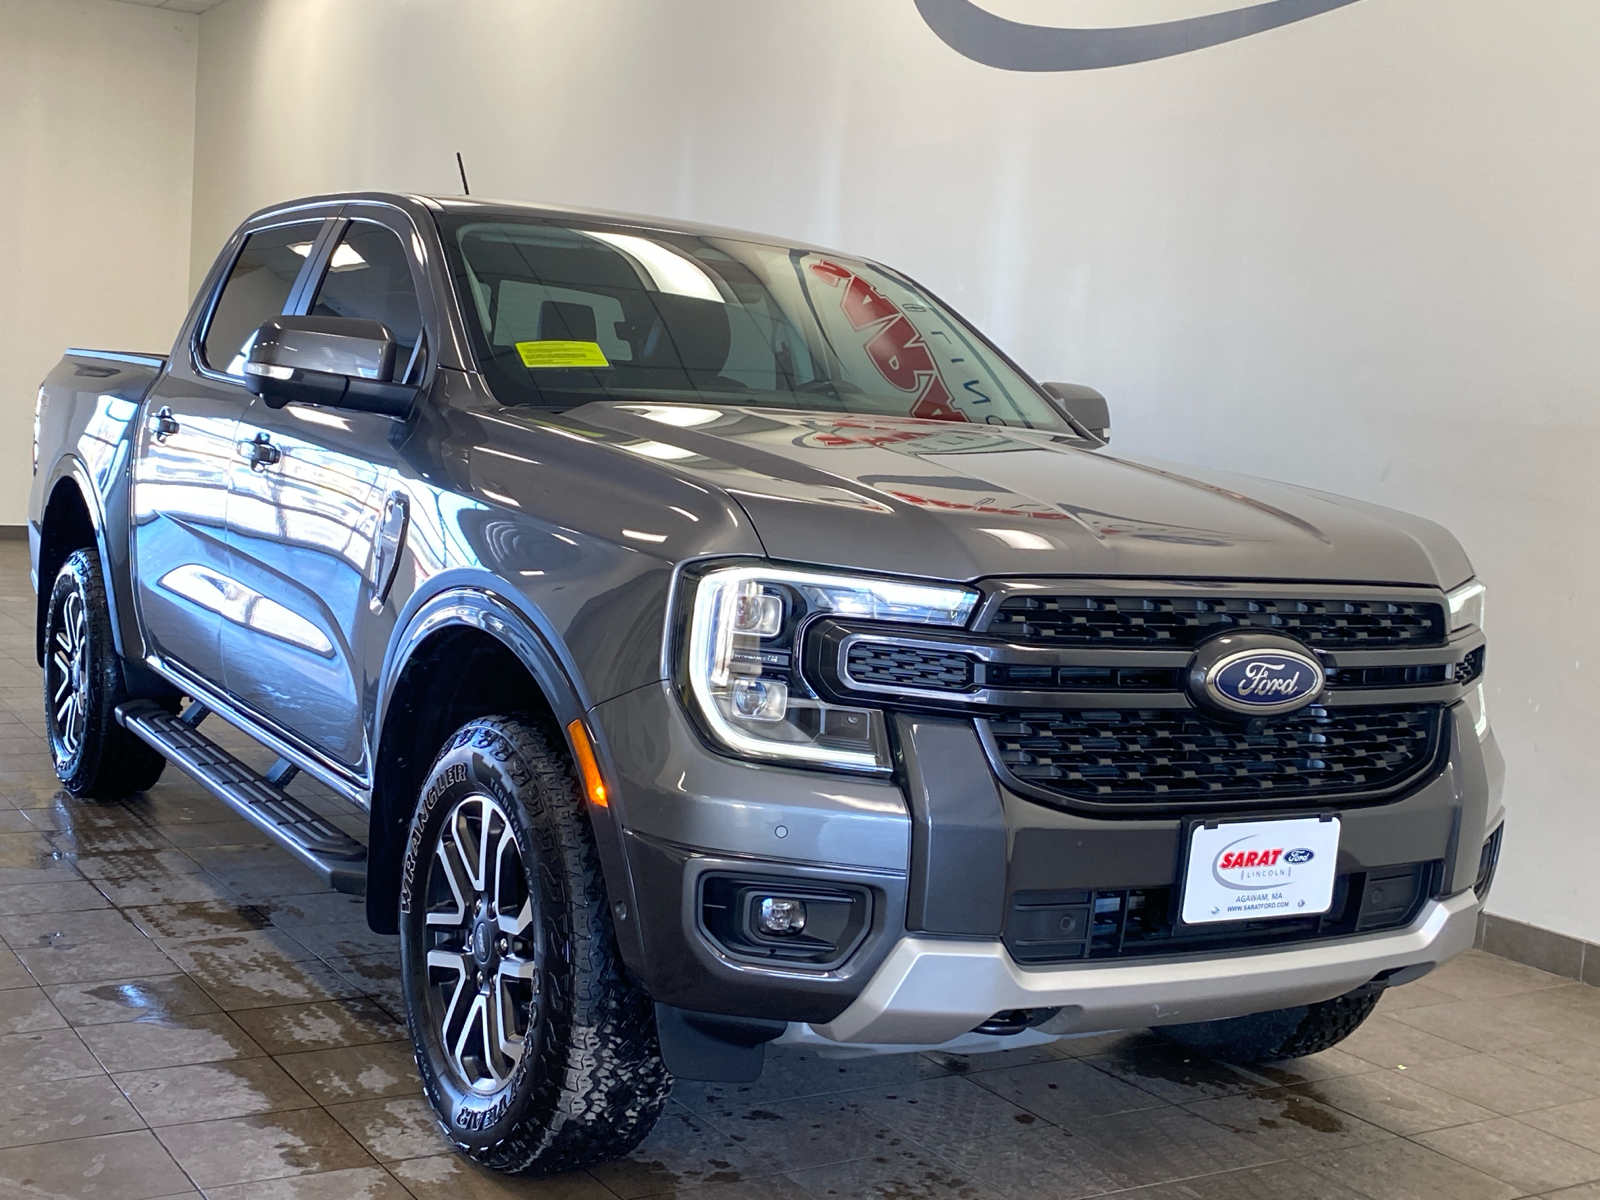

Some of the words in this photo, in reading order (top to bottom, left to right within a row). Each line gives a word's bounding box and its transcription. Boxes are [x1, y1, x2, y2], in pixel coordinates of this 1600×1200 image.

[1238, 662, 1299, 695] Ford
[490, 777, 526, 852] TERRITORY
[401, 762, 468, 914] WRANGLER
[1219, 848, 1283, 869] SARAT
[1288, 850, 1310, 862] Ford
[1247, 870, 1285, 878] LINCOLN
[1227, 902, 1289, 912] WWW.SARATFORD.COM
[1235, 894, 1269, 902] AGAWAM,
[1271, 892, 1283, 900] MA
